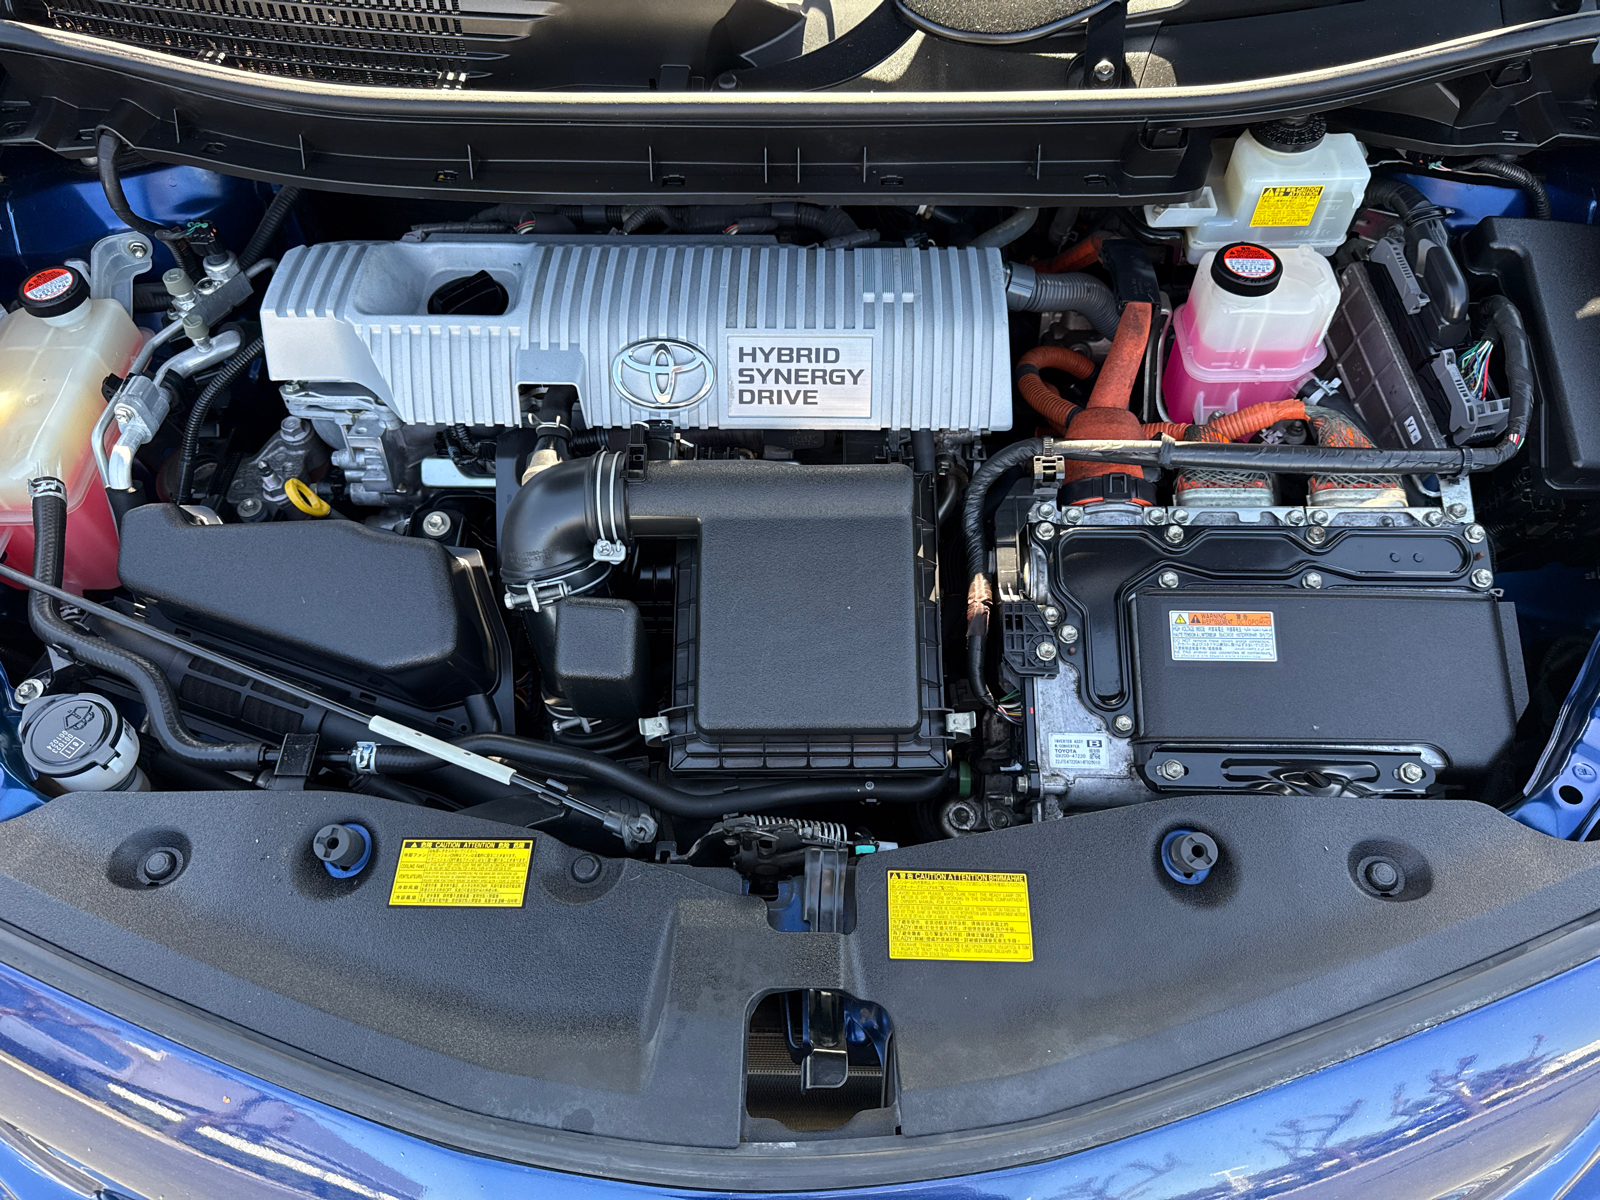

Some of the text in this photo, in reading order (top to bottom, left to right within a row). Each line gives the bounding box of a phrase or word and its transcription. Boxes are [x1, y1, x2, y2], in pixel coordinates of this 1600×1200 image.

[738, 346, 840, 363] HYBRID
[738, 368, 865, 385] SYNERGY
[738, 389, 818, 405] DRIVE
[45, 730, 68, 751] 001024
[51, 732, 75, 754] 001023
